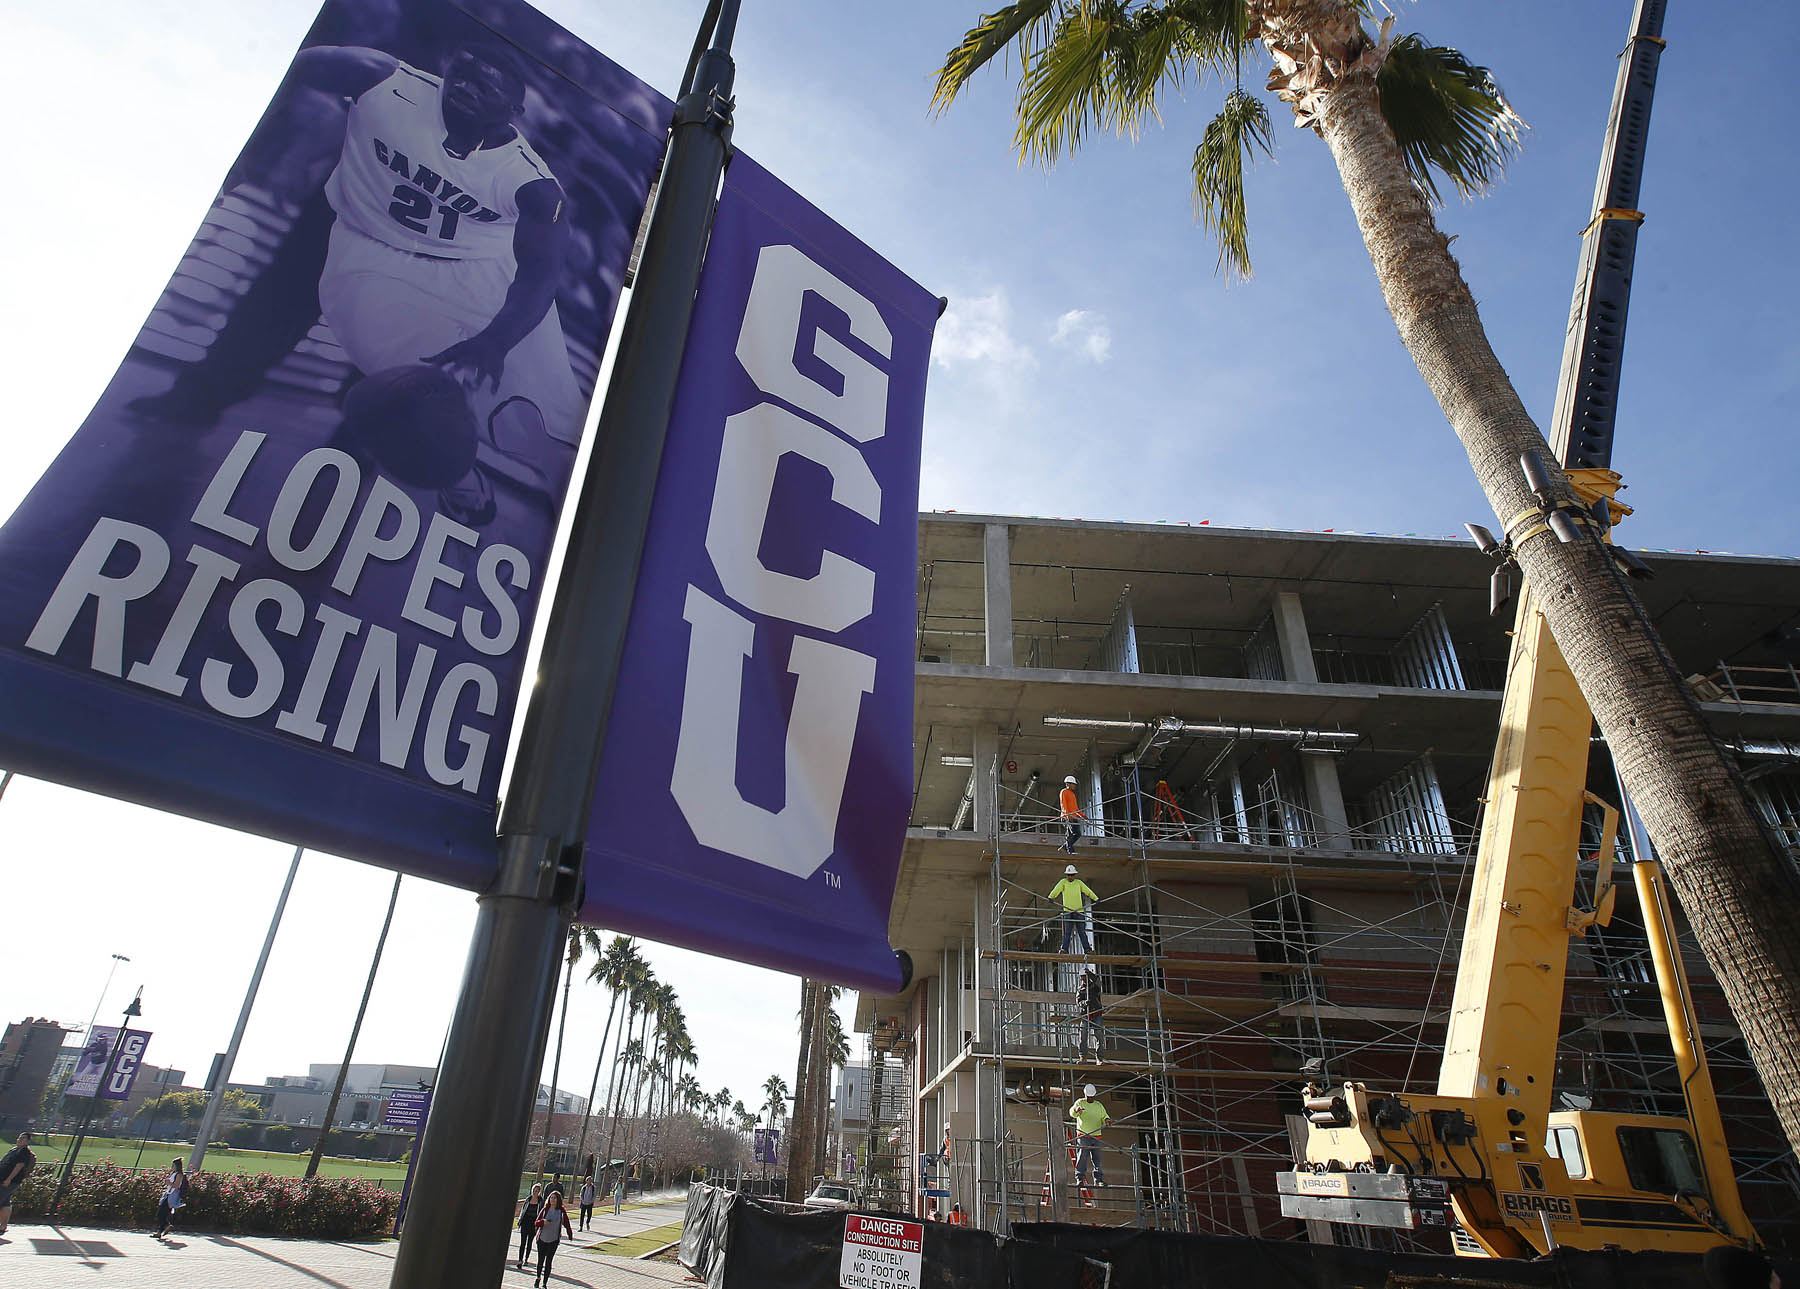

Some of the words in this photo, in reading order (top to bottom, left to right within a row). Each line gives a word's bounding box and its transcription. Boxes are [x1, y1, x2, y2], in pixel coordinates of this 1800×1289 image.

[373, 137, 502, 222] CANYON
[389, 184, 460, 241] 21
[190, 429, 532, 656] LOPES
[669, 243, 893, 880] GCU
[24, 516, 499, 794] RISING
[823, 870, 842, 889] TM
[108, 1035, 145, 1093] GCU
[1307, 1179, 1341, 1188] BRAGG
[1503, 1193, 1572, 1214] BRAGG
[860, 1218, 904, 1236] DANGER
[847, 1231, 901, 1249] CONSTRUCTION
[902, 1239, 919, 1251] SITE
[857, 1248, 904, 1266] ABSOLUTELY
[842, 1273, 877, 1289] VEHICLE
[853, 1261, 866, 1273] NO
[871, 1265, 894, 1279] FOOT
[896, 1269, 910, 1282] OR
